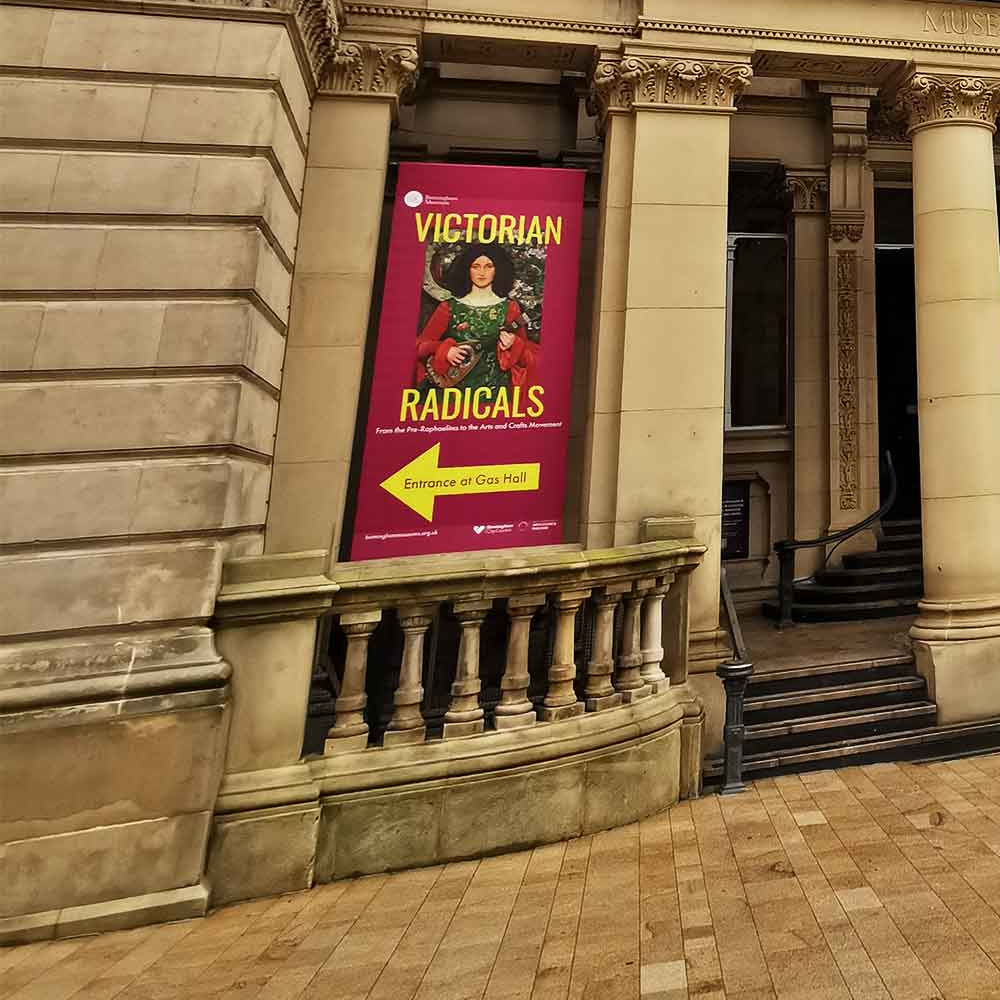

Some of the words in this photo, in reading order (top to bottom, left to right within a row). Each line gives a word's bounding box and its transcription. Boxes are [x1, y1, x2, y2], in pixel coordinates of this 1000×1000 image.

[415, 212, 563, 246] VICTORIAN
[399, 385, 545, 422] RADICALS
[375, 426, 393, 434] From
[394, 425, 406, 433] the
[468, 423, 479, 431] the
[480, 422, 494, 430] Arts
[494, 421, 508, 430] and
[508, 421, 528, 429] Crafts
[403, 478, 457, 490] Entrance
[460, 477, 473, 487] at
[475, 474, 500, 486] Gas
[503, 471, 527, 484] Hall
